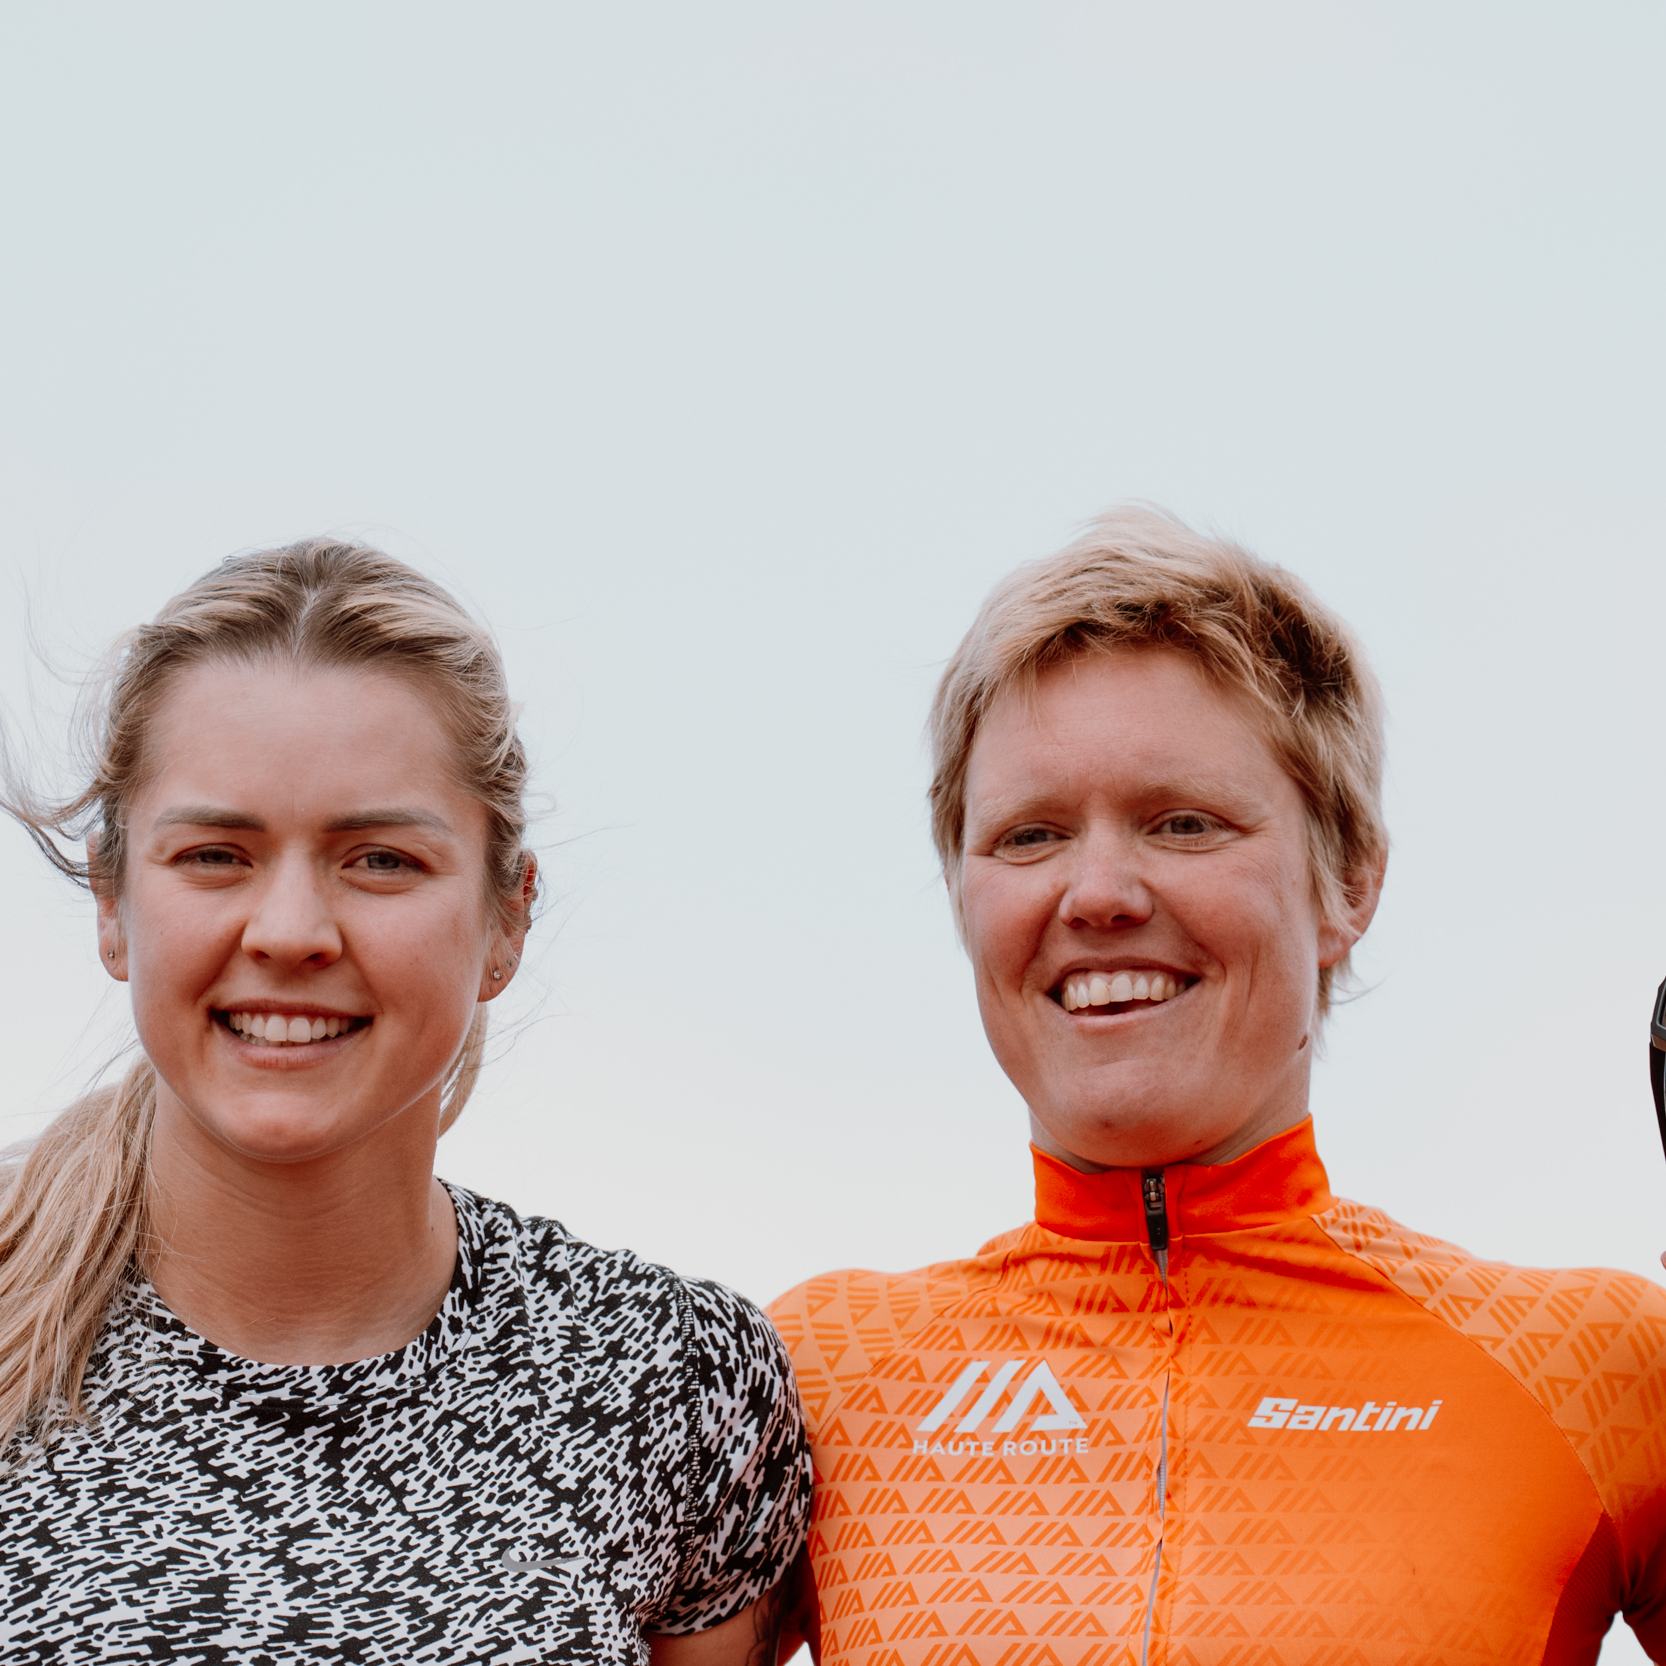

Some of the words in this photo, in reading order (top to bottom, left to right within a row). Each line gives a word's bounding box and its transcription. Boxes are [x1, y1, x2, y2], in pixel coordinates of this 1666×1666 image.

[1247, 1396, 1443, 1432] Santini
[912, 1439, 995, 1457] HAUTE
[1003, 1437, 1090, 1457] ROUTE
